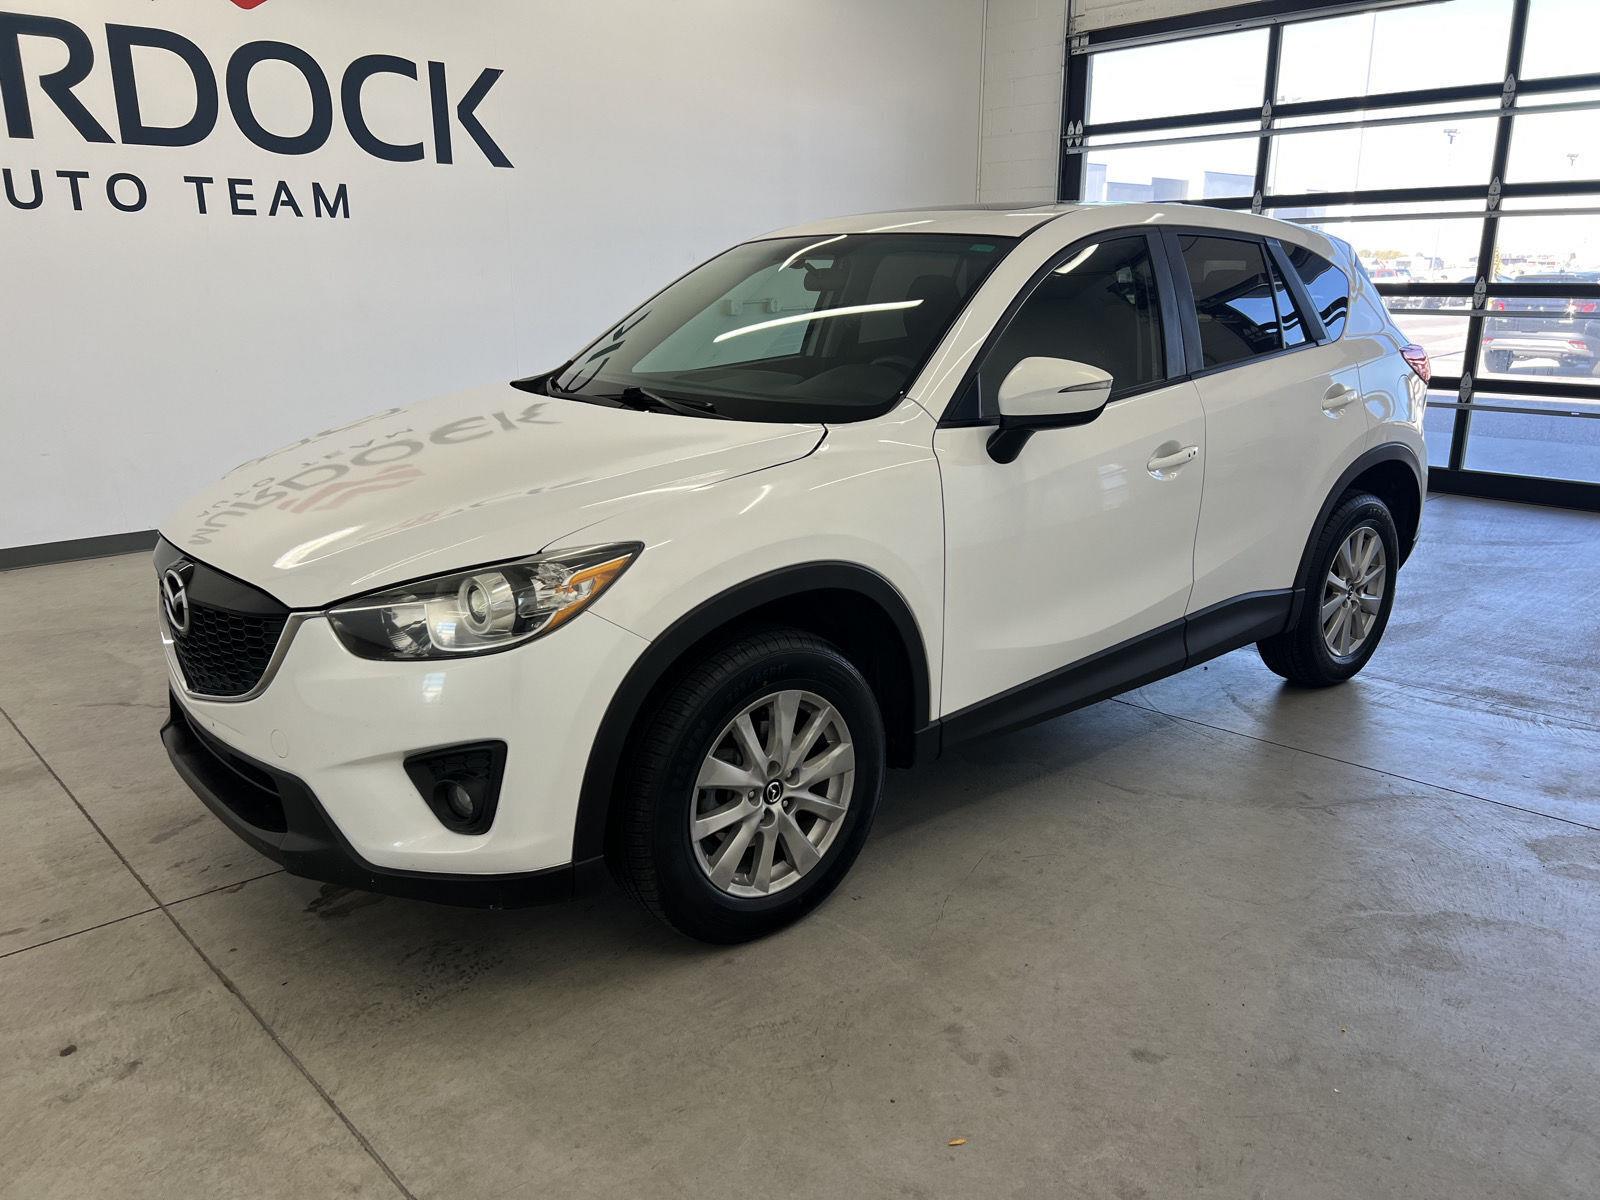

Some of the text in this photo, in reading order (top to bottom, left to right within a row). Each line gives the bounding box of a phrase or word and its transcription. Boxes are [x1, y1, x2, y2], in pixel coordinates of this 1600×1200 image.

[0, 11, 514, 168] RDOCK
[2, 168, 350, 218] UTO TEAM
